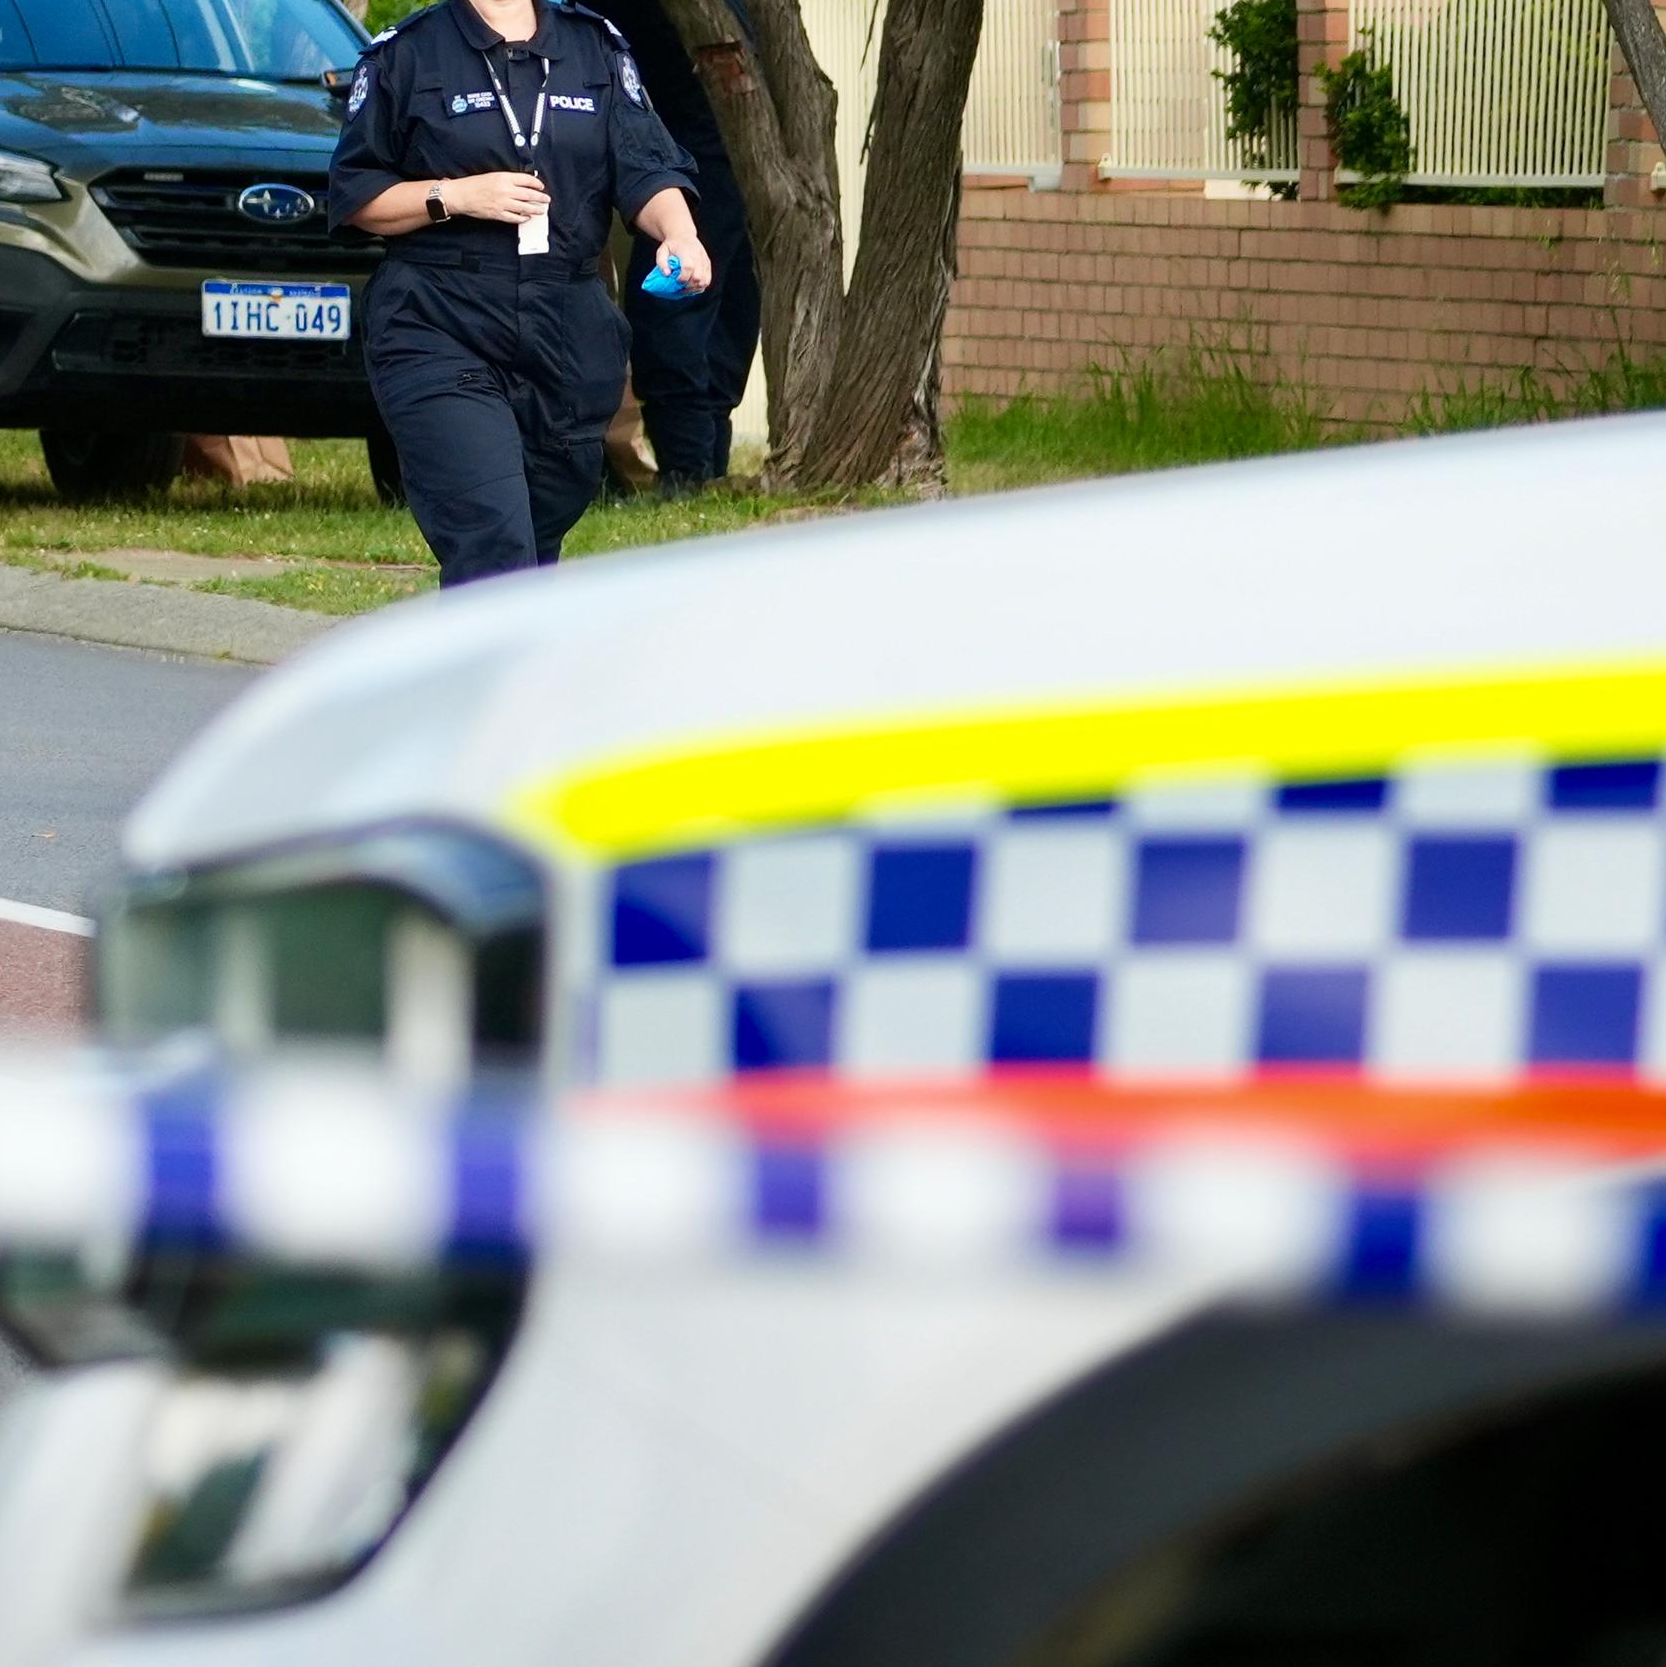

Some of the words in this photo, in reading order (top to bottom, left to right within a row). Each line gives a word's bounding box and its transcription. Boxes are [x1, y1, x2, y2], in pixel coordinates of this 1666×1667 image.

[549, 95, 596, 112] POLICE
[215, 301, 280, 332] 1IHC
[296, 304, 341, 333] 049
